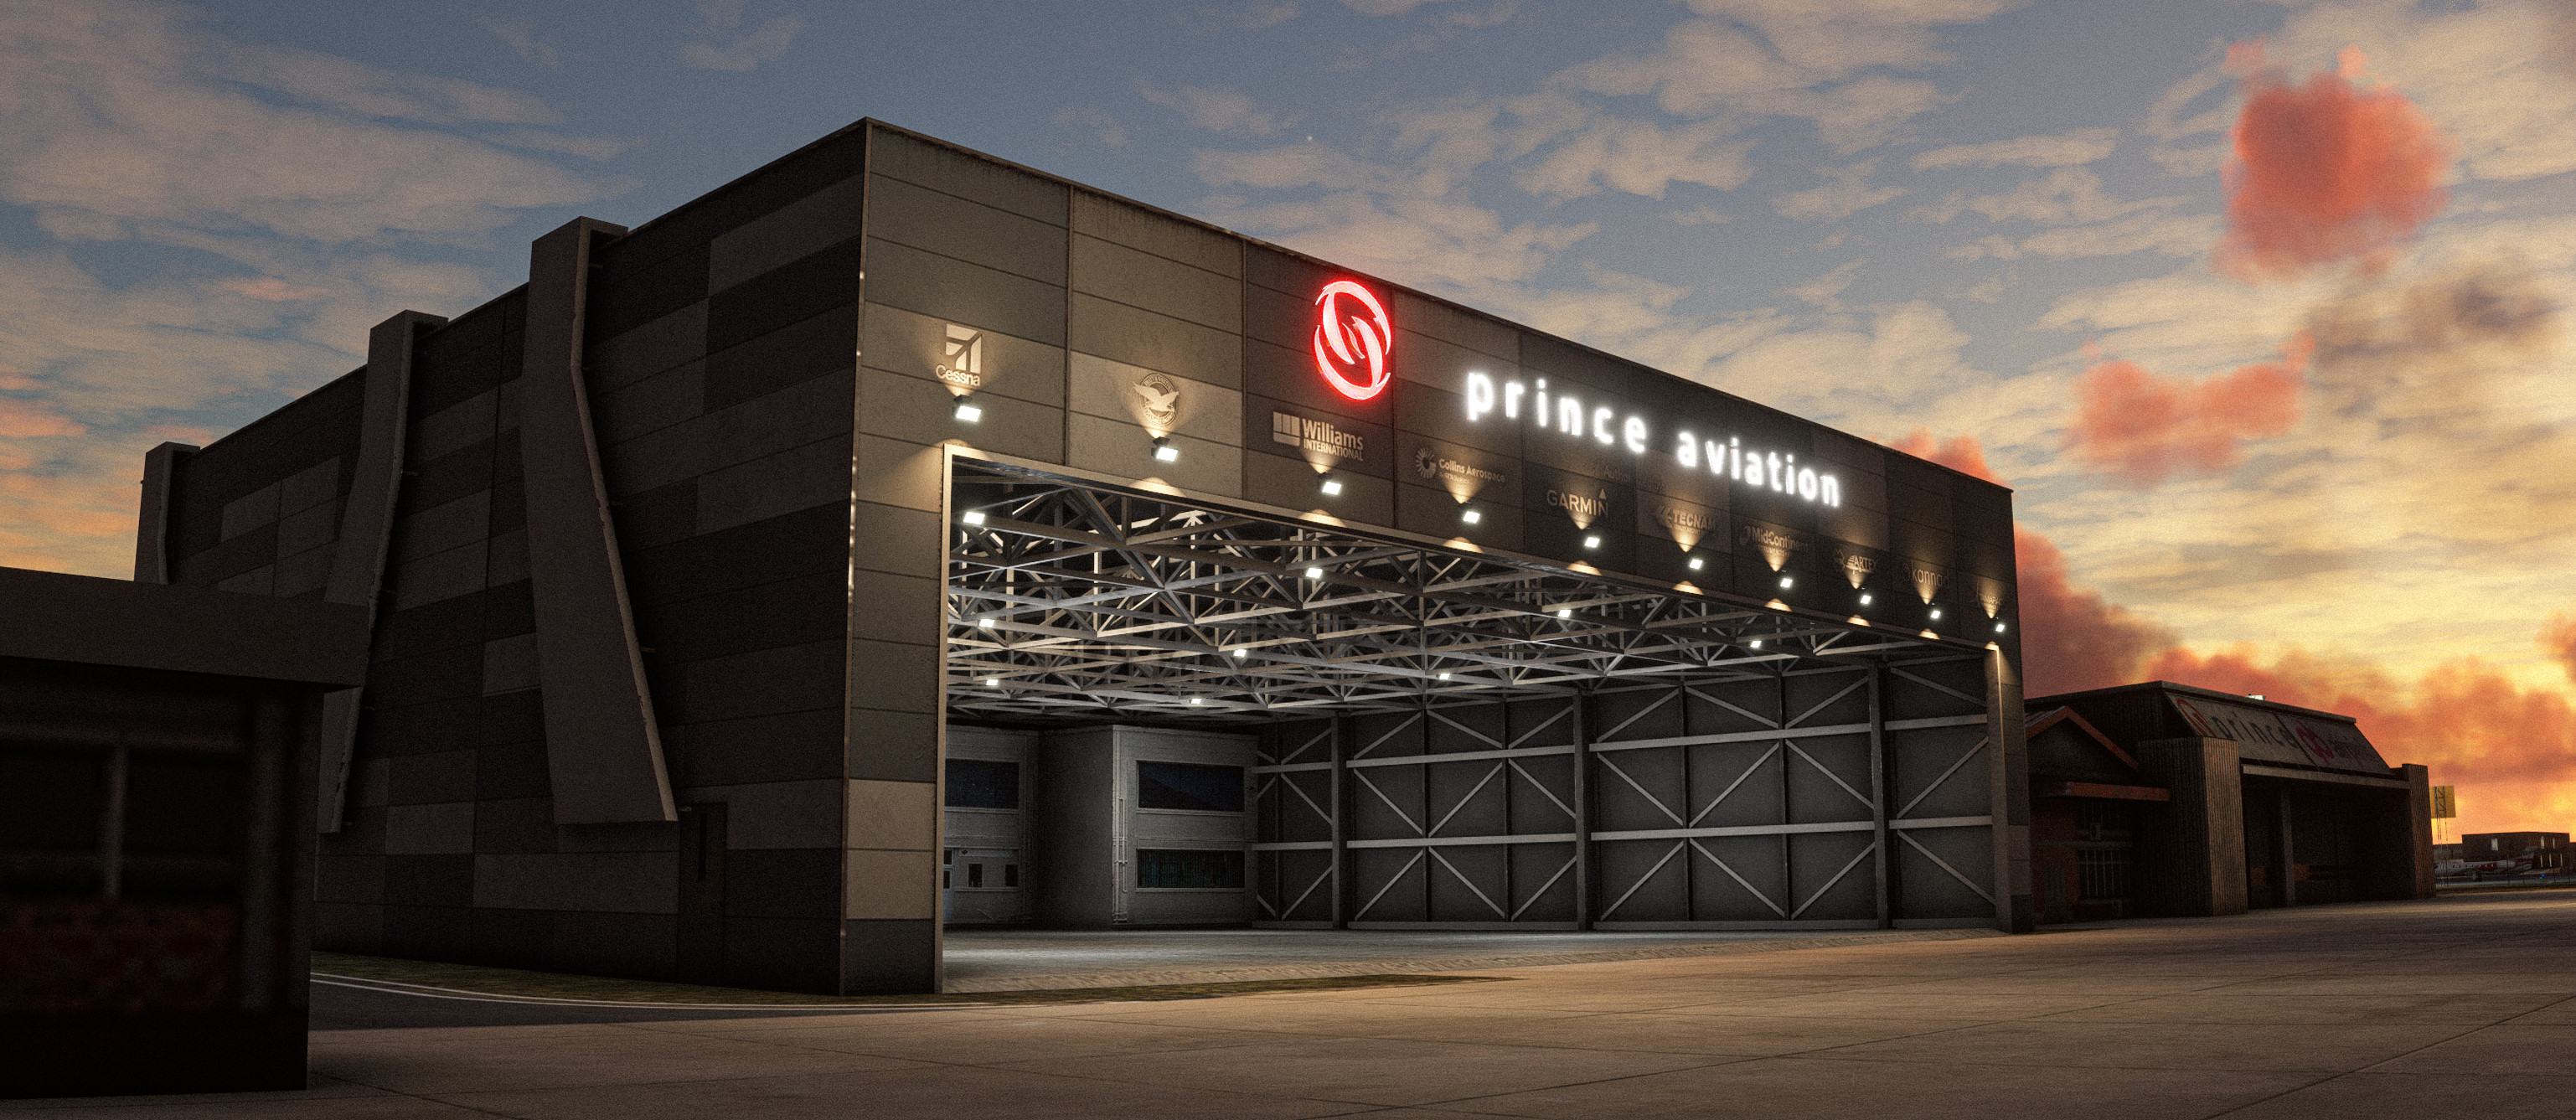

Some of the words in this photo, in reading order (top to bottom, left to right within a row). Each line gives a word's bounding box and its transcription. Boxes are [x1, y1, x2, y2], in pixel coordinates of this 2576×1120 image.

[936, 364, 981, 387] Cessna
[1302, 419, 1364, 451] Williams
[1468, 373, 1647, 453] prince
[1678, 431, 1840, 507] aviation
[1303, 439, 1364, 462] INTERNATIONAL
[1438, 458, 1465, 473] Collins
[1466, 466, 1505, 483] Aerospace
[1546, 489, 1608, 516] GARMIN
[1673, 509, 1716, 532] TECNAM
[2211, 711, 2298, 749] prince
